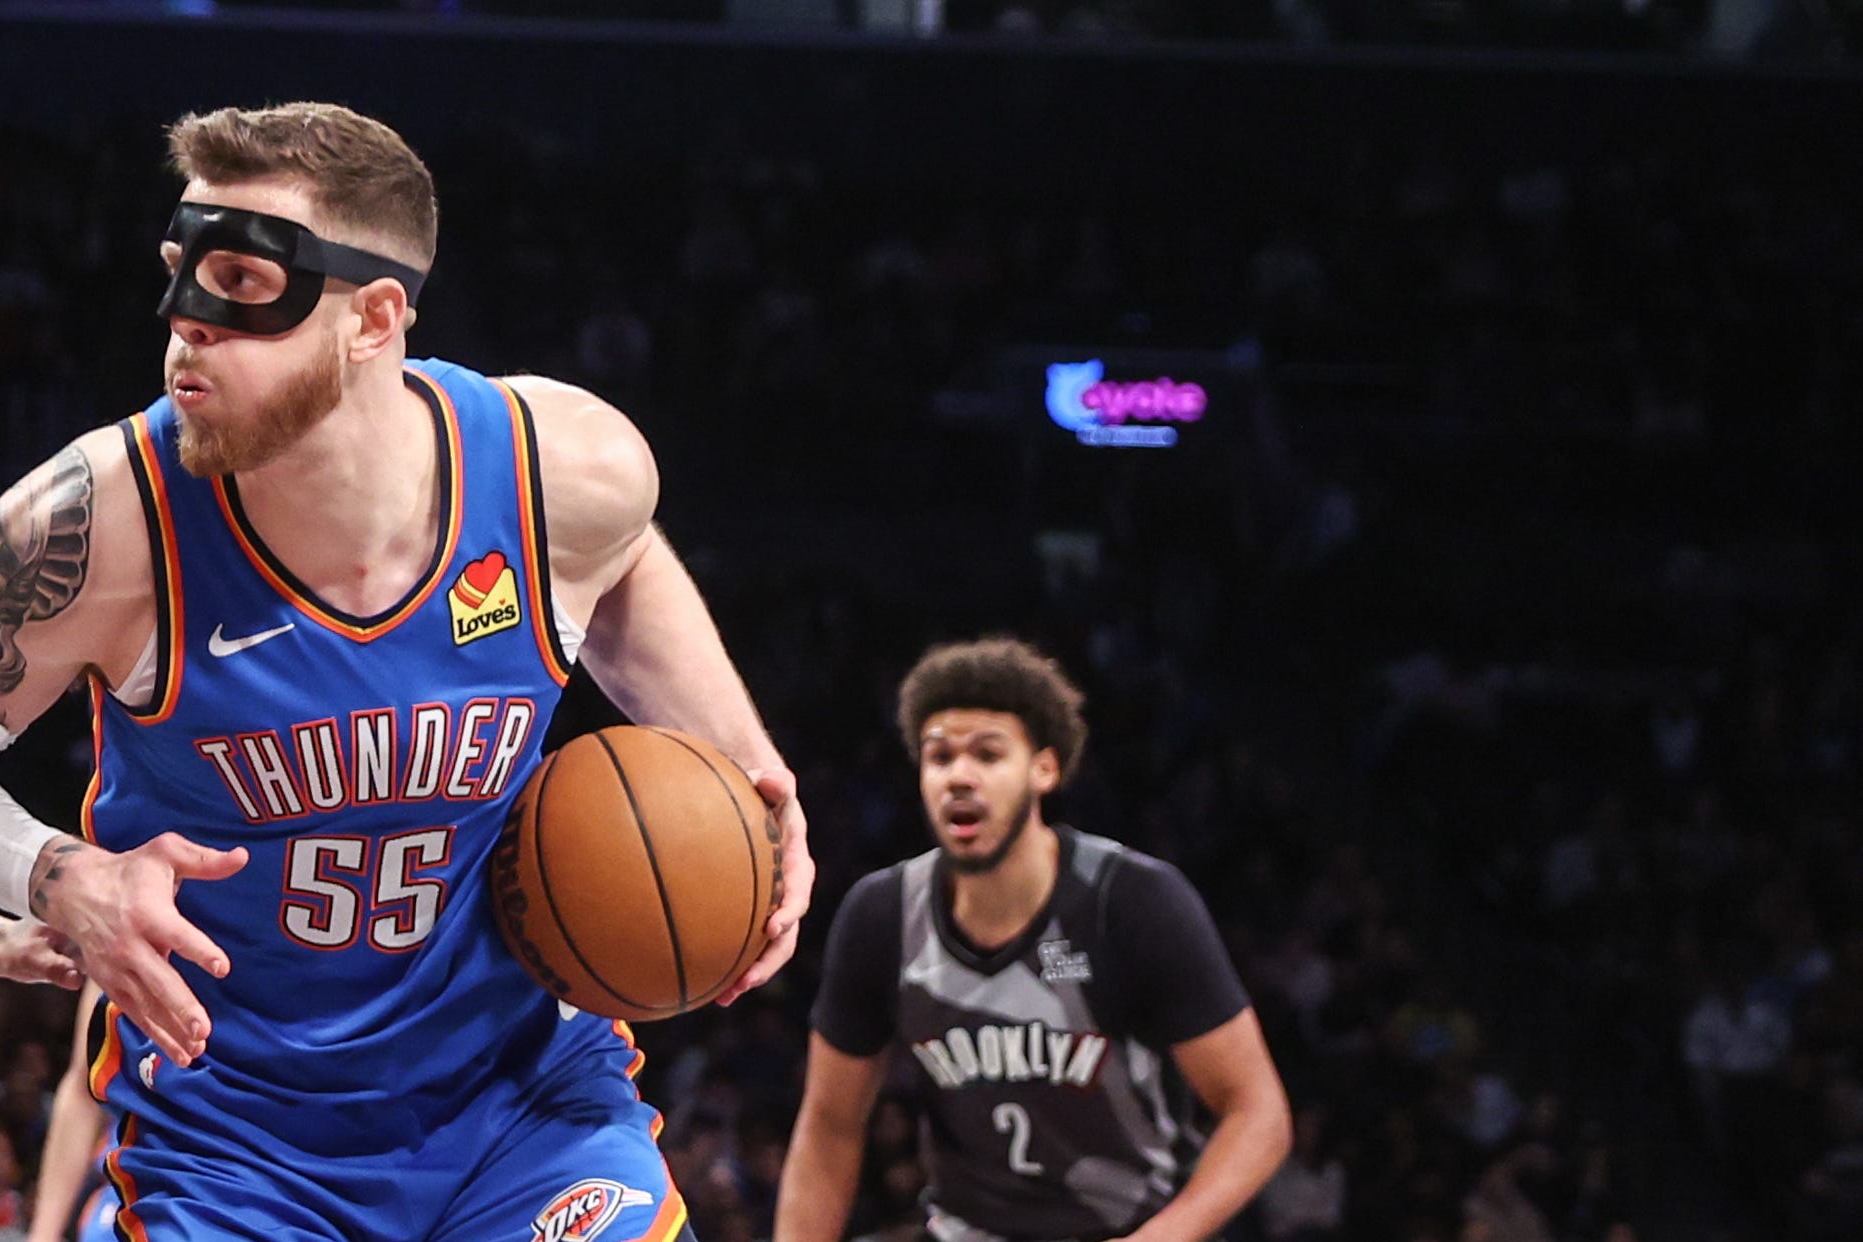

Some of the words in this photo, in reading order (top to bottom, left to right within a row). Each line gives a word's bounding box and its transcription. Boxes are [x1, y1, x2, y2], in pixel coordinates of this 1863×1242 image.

[193, 698, 536, 824] THUNDER
[278, 826, 458, 954] 55
[991, 1101, 1044, 1175] 2
